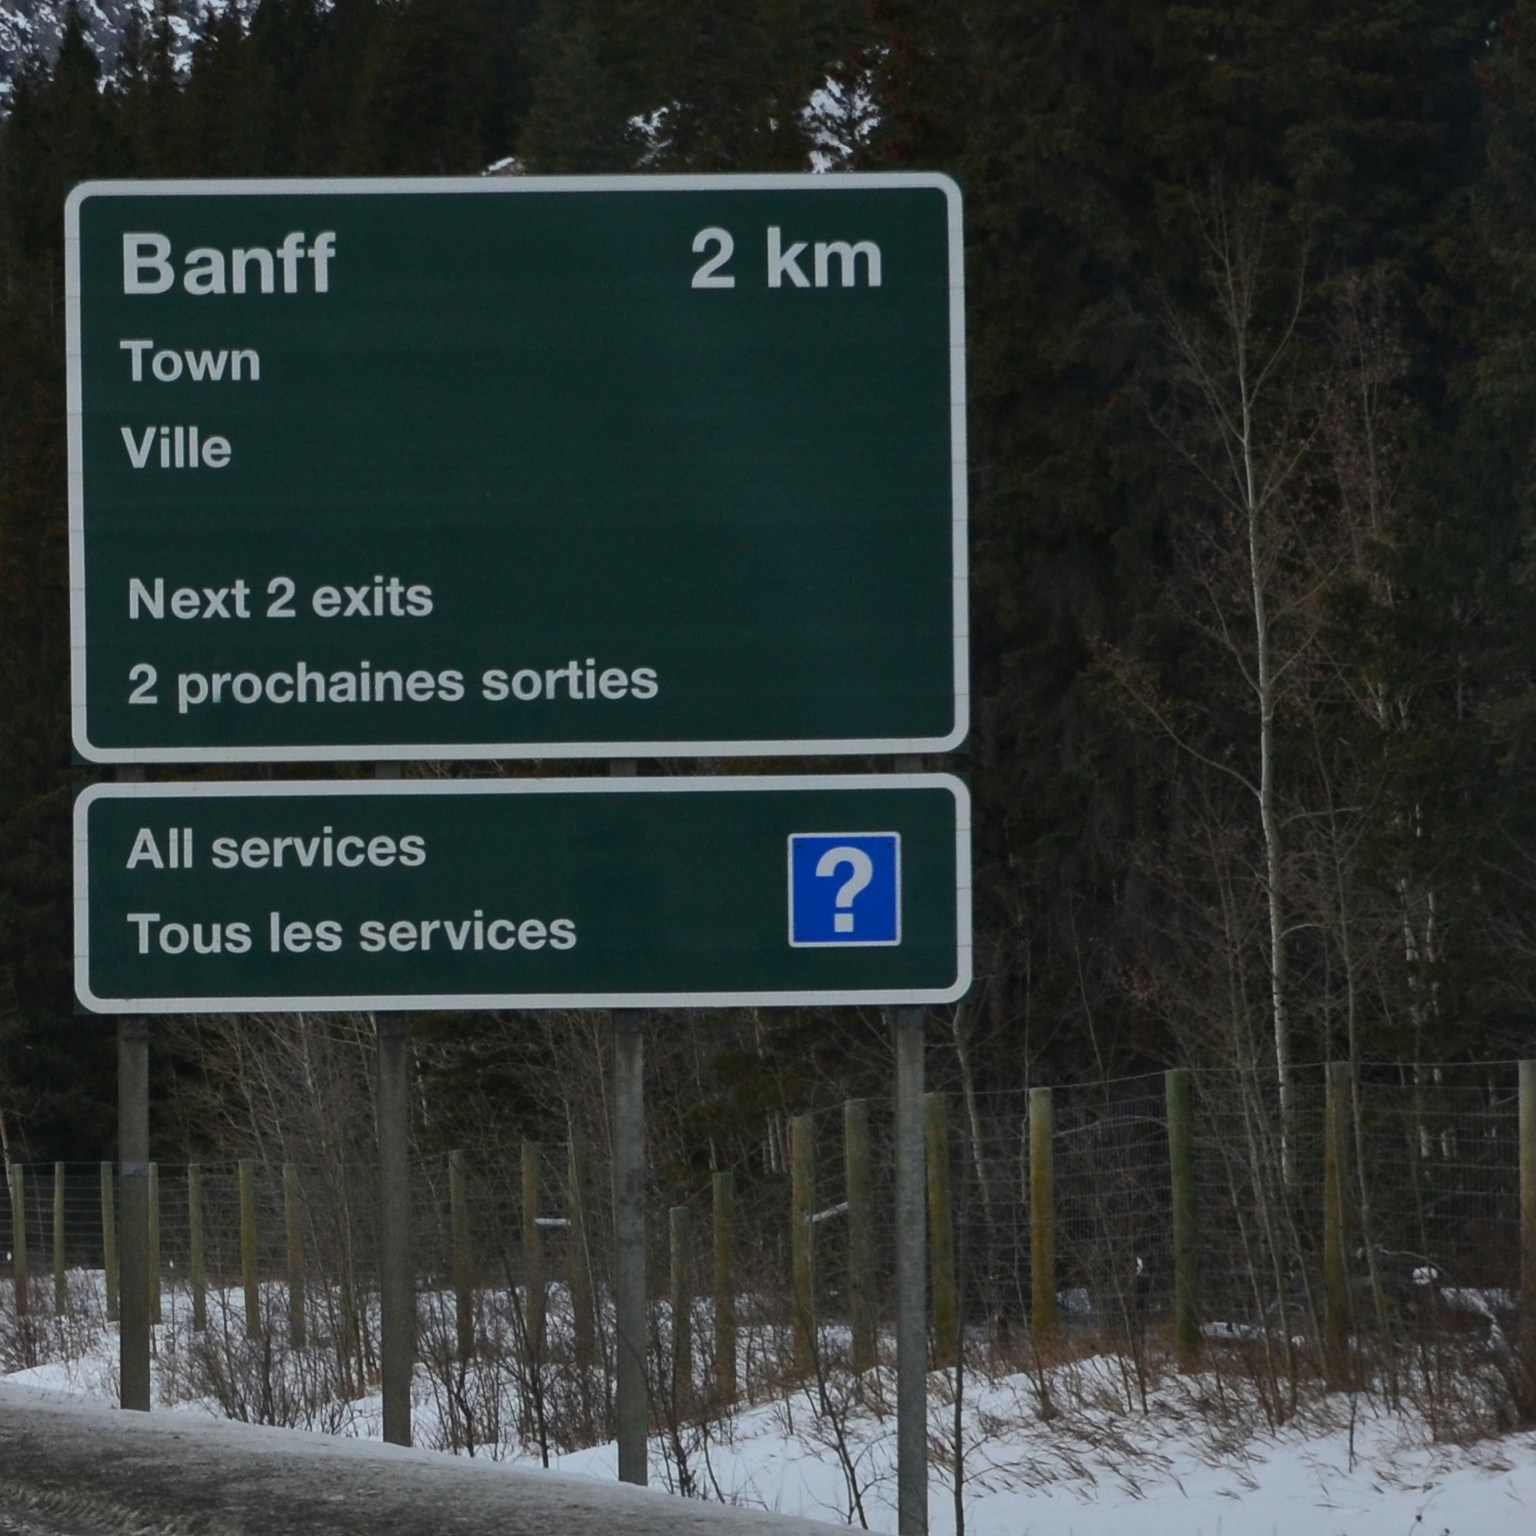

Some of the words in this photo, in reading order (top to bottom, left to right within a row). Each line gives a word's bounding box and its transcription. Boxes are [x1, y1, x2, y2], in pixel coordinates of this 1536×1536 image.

[122, 231, 336, 296] Banff
[691, 226, 735, 289] 2
[766, 226, 882, 288] km
[119, 339, 260, 382] Town
[120, 425, 232, 469] Ville
[129, 576, 252, 620] Next
[266, 576, 296, 618] 2
[312, 574, 434, 618] exits
[128, 662, 158, 705] 2
[177, 660, 465, 714] prochaines
[482, 657, 659, 702] sorties
[125, 827, 193, 869] All
[211, 826, 426, 869] services
[126, 913, 252, 955] Tous
[270, 911, 343, 953] les
[359, 910, 577, 953] services
